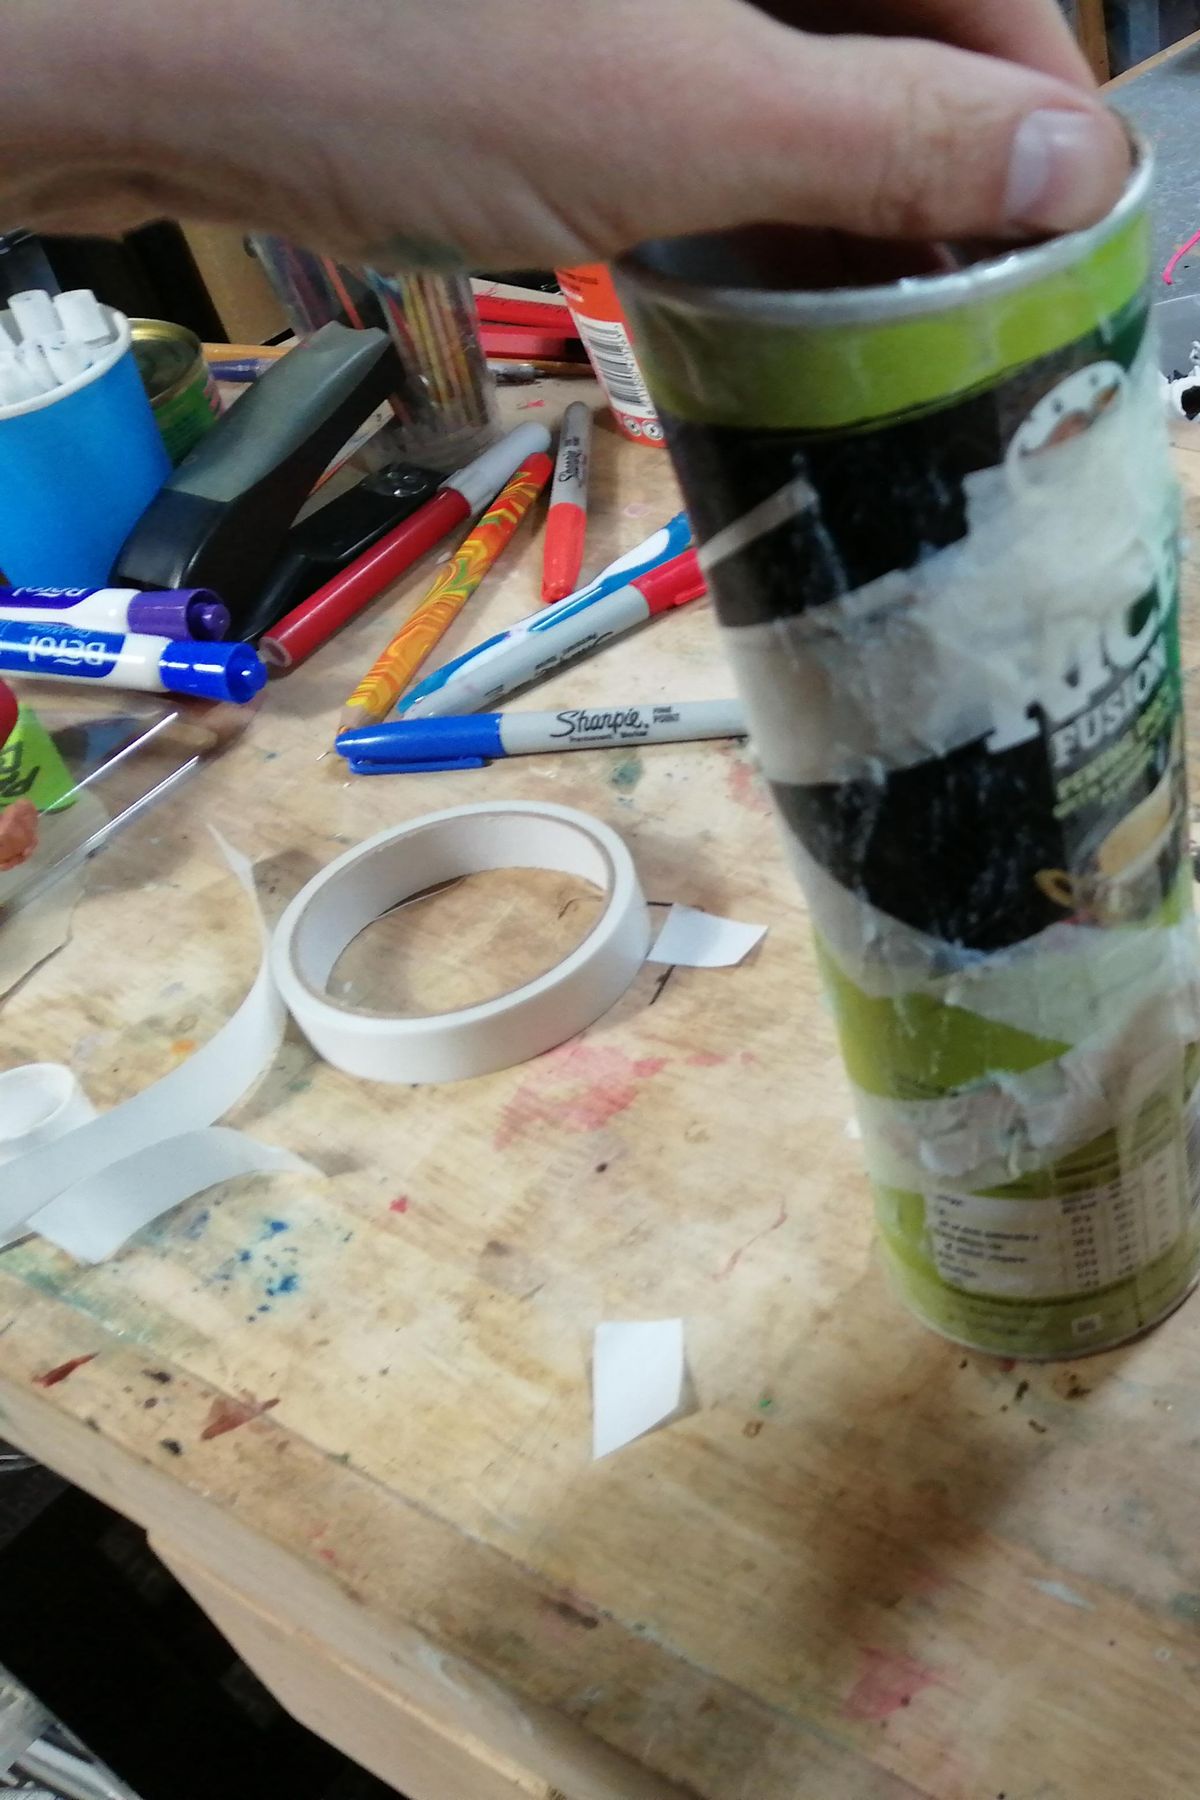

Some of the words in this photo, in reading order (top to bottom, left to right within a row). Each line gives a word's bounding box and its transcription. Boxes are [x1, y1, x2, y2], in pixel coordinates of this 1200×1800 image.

[27, 635, 106, 666] Berol
[1052, 632, 1168, 769] FUSION
[549, 707, 642, 738] Sharpie
